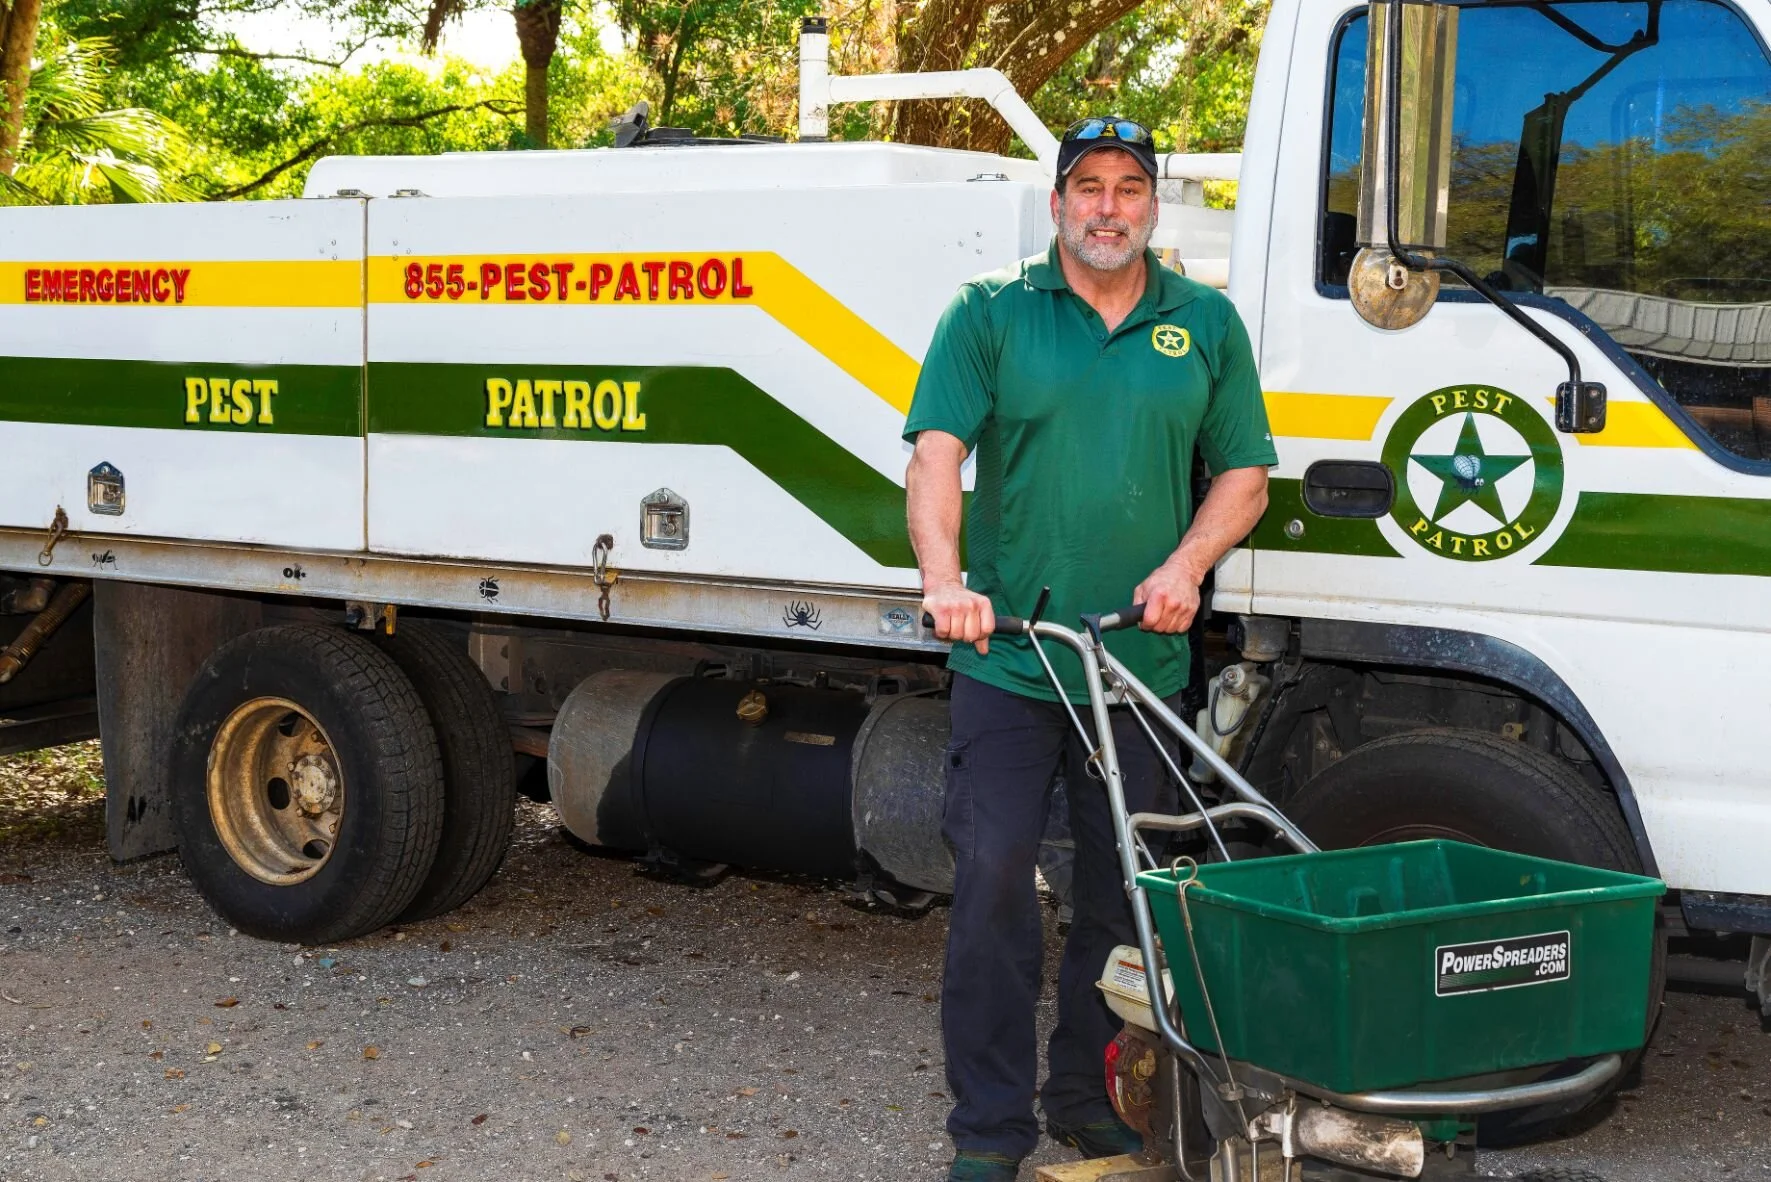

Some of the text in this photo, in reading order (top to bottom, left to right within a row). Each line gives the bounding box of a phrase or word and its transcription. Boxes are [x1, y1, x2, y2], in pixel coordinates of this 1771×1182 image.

[25, 257, 754, 303] EMERGENCY 855-PEST-PATROL
[184, 377, 647, 431] PEST PATROL
[1430, 389, 1513, 415] PEST
[1408, 517, 1536, 557] PATROL
[1535, 960, 1566, 976] .COM
